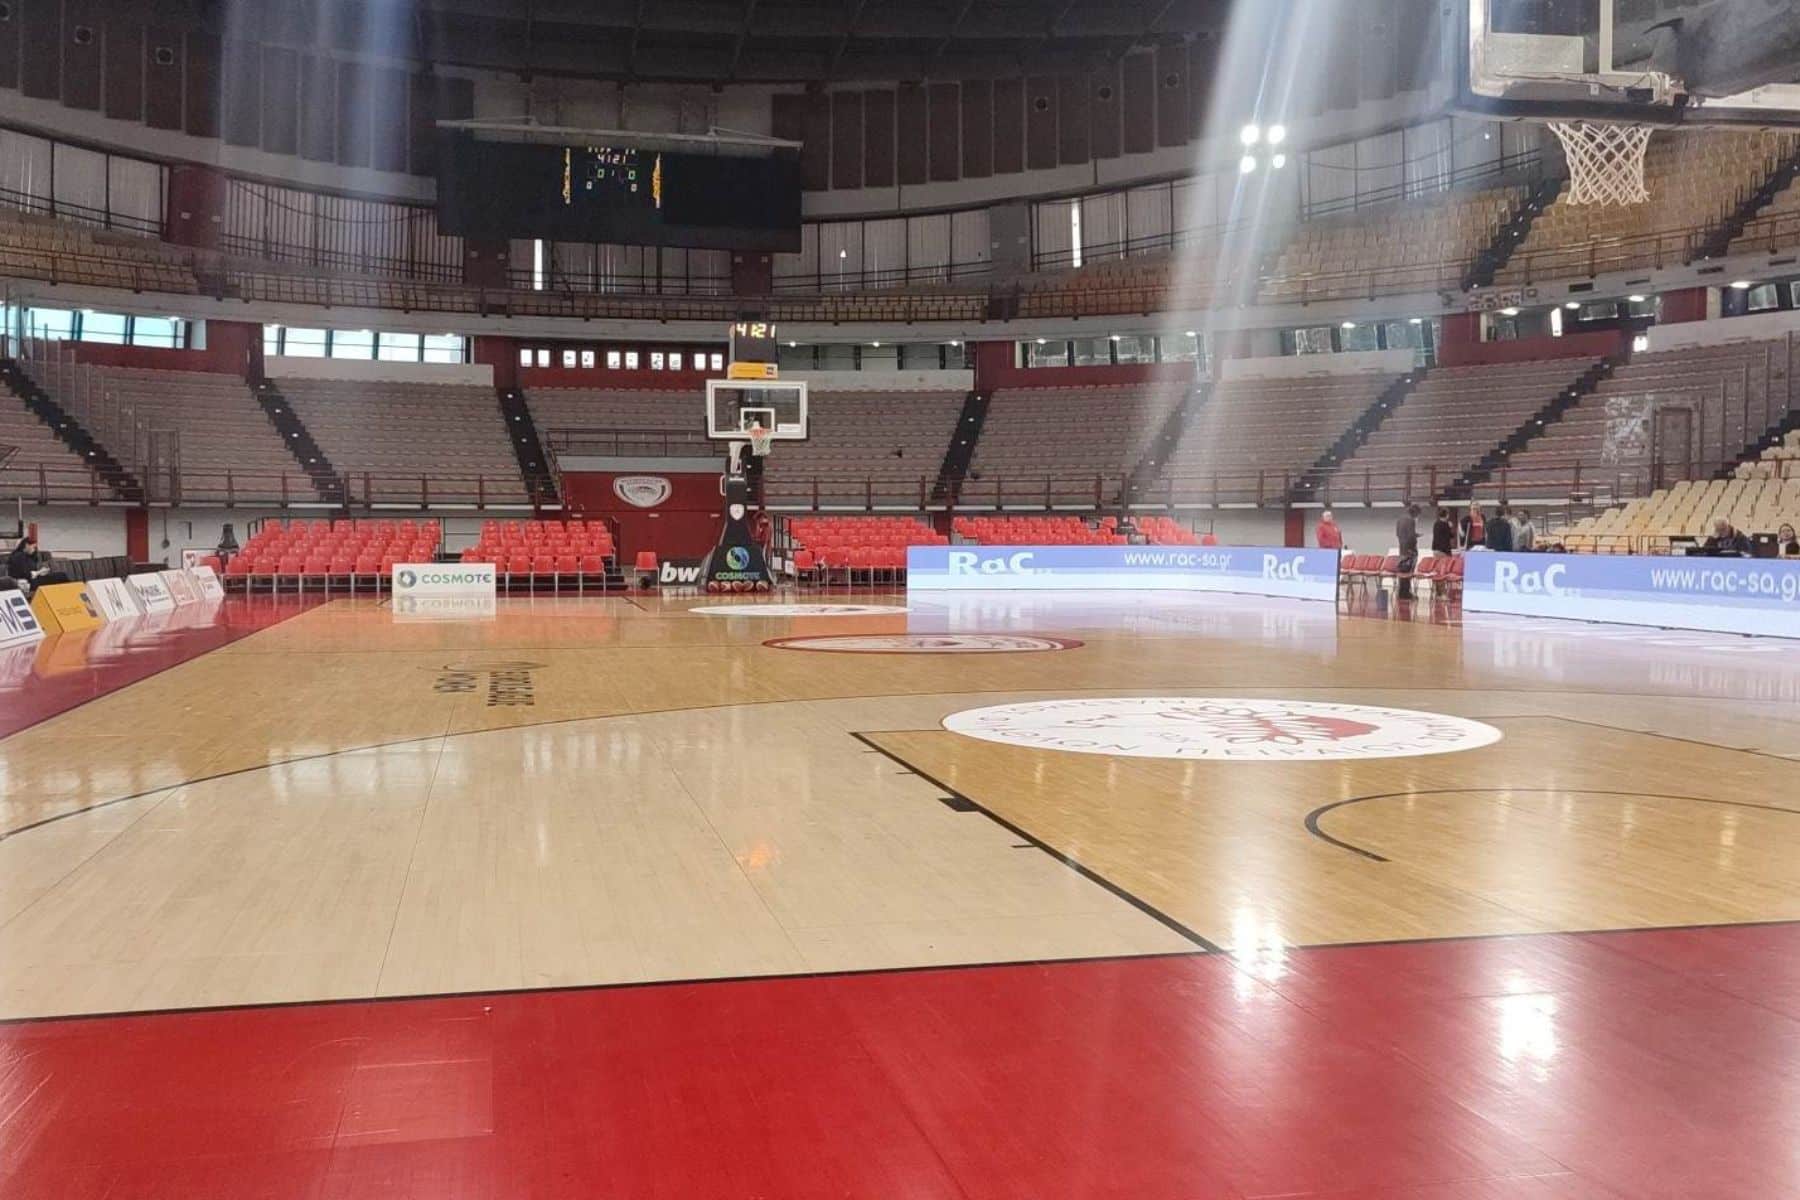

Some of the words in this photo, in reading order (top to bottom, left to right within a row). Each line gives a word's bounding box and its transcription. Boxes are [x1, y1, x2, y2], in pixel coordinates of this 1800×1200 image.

[949, 551, 1034, 575] RaC
[1263, 553, 1305, 583] RaC
[421, 574, 492, 584] COSMOTE
[1495, 560, 1566, 596] RaC
